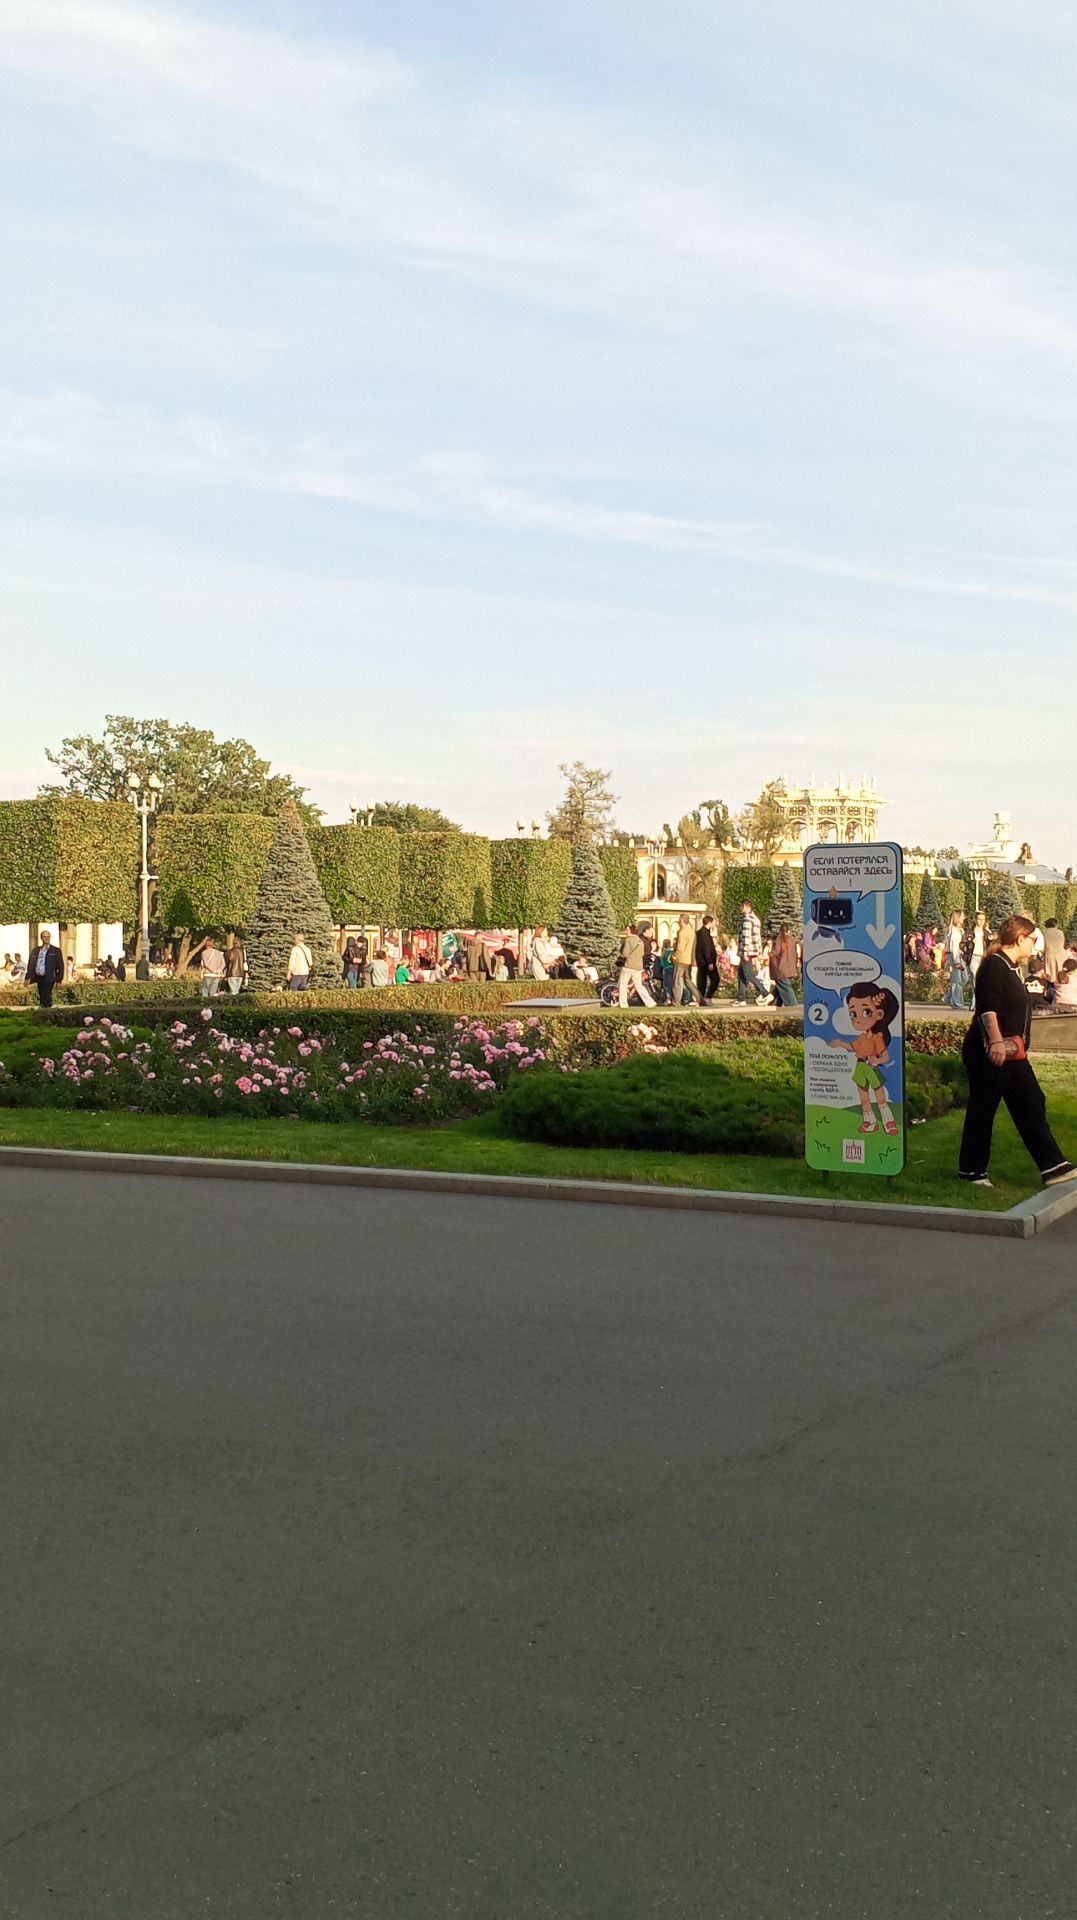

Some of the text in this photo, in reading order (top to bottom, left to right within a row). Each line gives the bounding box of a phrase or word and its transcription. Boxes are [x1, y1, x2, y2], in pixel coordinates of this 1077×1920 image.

[814, 856, 888, 865] ЕСЛИ ПОТЕРЯЛСЯ
[810, 867, 892, 876] ОСТАВАЙСЯ ЗДЕСЬ
[814, 1008, 823, 1021] 2
